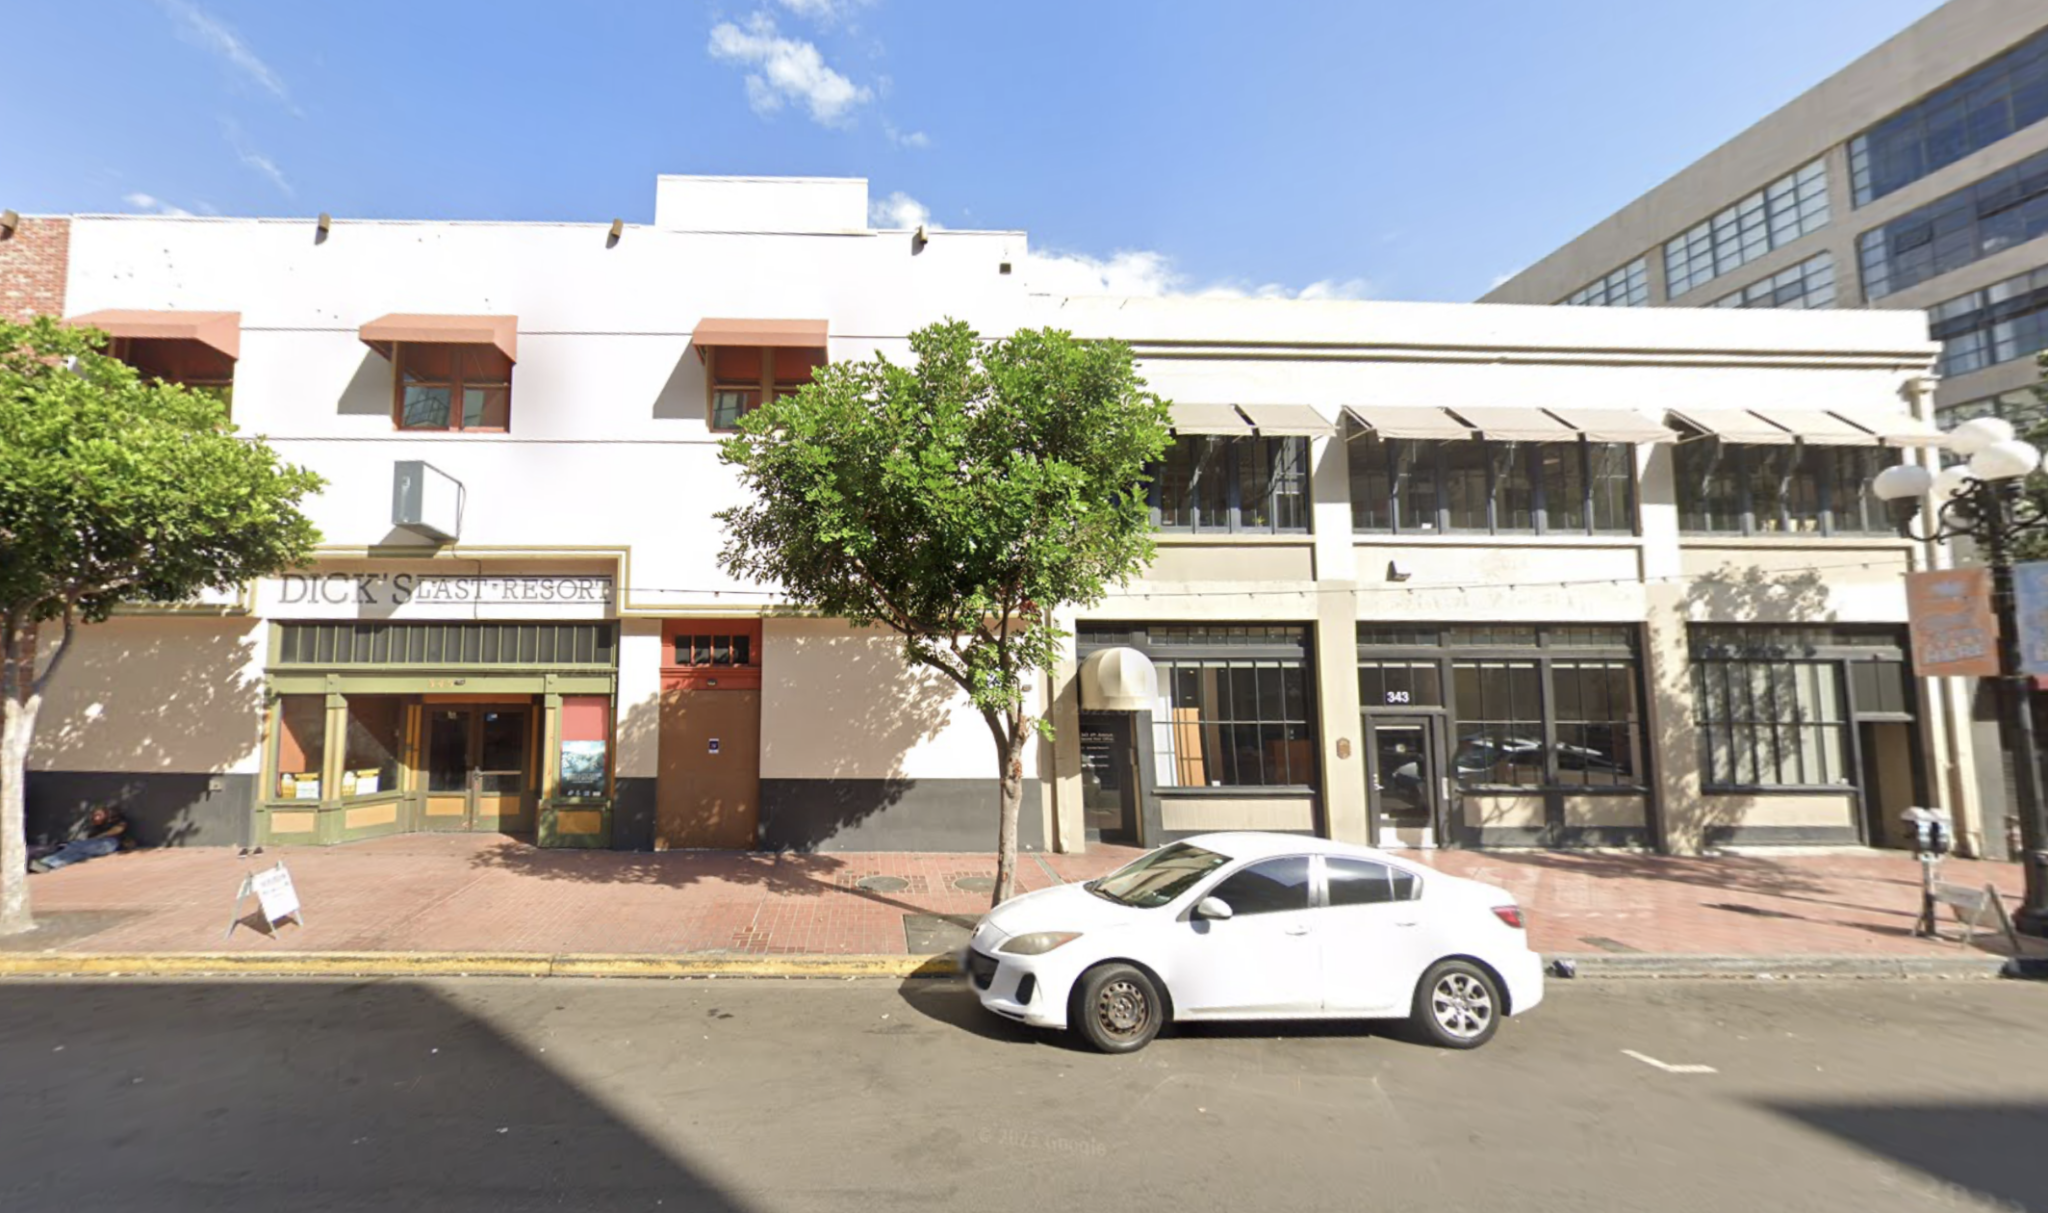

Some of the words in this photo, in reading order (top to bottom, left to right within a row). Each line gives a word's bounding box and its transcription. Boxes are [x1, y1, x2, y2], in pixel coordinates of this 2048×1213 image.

[278, 572, 412, 604] DICK'S
[416, 578, 487, 600] LAST
[502, 578, 612, 600] RESORT
[1386, 691, 1409, 703] 343
